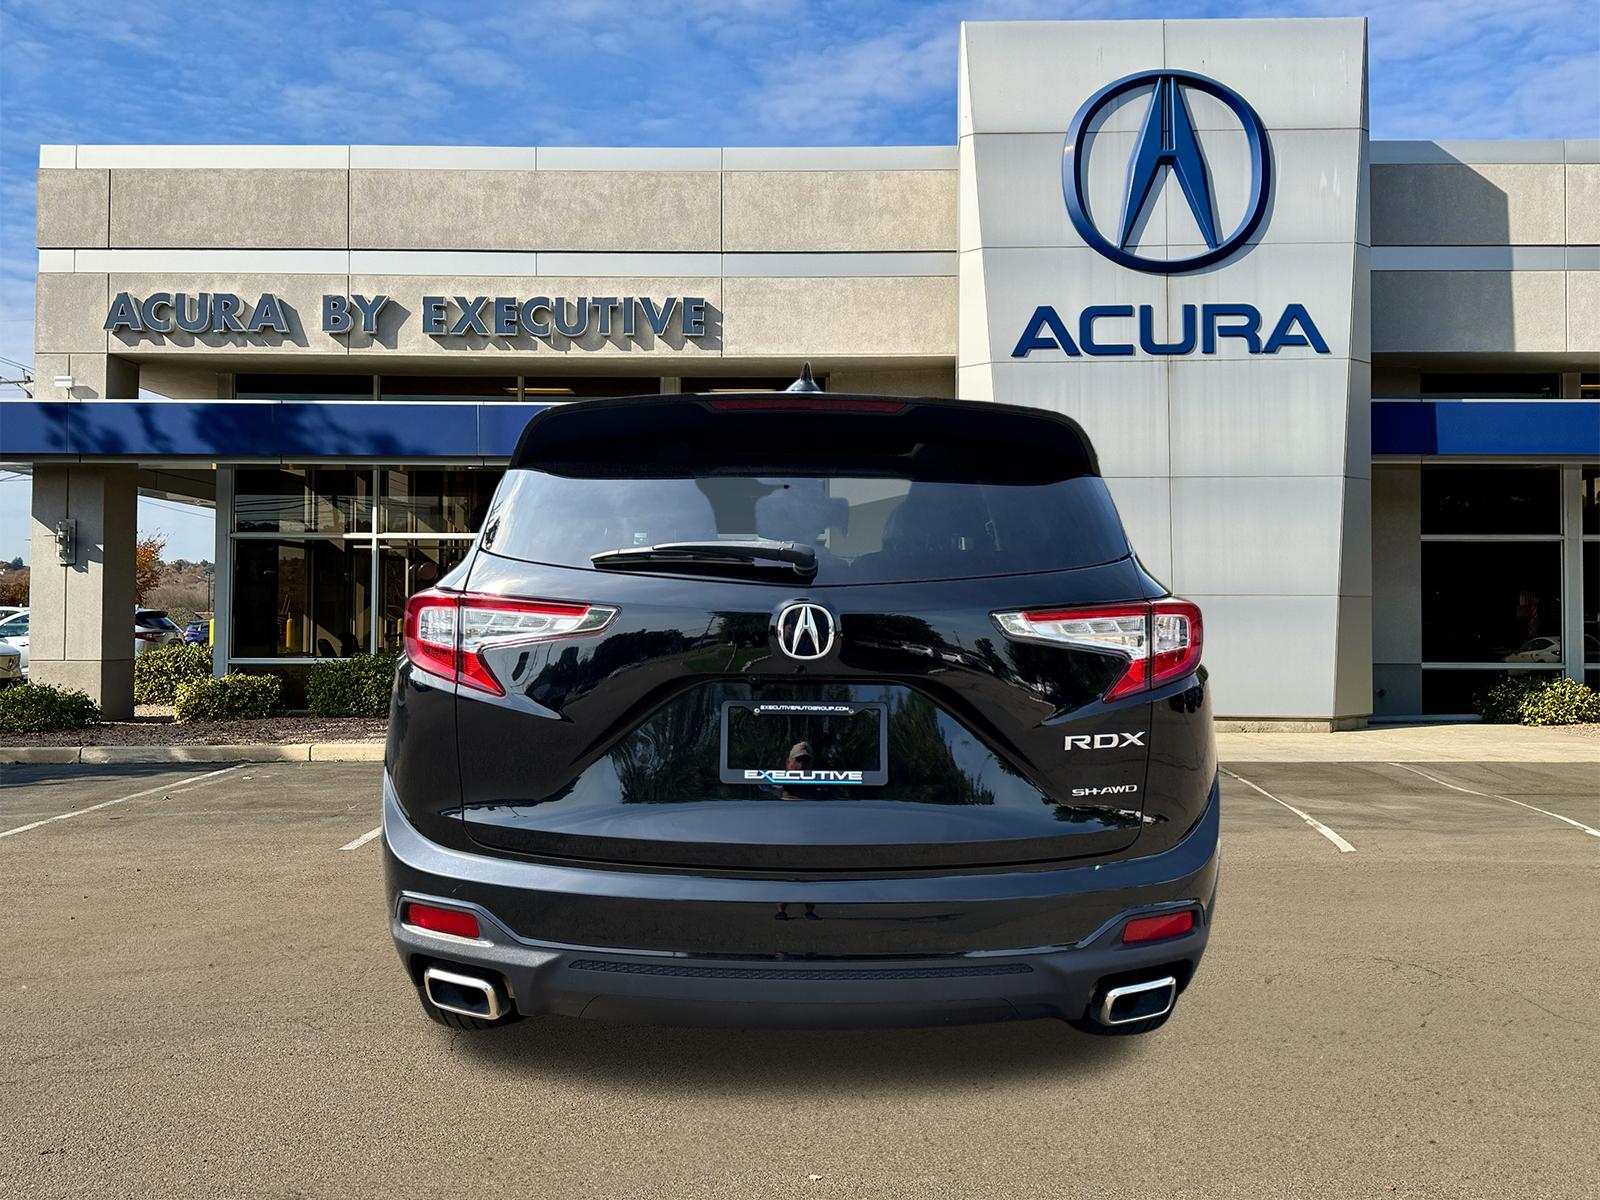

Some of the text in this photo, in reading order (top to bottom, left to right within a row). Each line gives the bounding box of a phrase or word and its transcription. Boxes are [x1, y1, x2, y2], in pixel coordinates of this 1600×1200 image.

[104, 291, 706, 337] ACURA BY EXECUTIVE
[1011, 304, 1332, 357] ACURA
[760, 704, 849, 712] EXECUTIVEAUTOGROUP.COM
[1064, 731, 1145, 751] RDX
[744, 770, 863, 781] EXECUTIVE
[1071, 784, 1138, 797] SH-AWD
